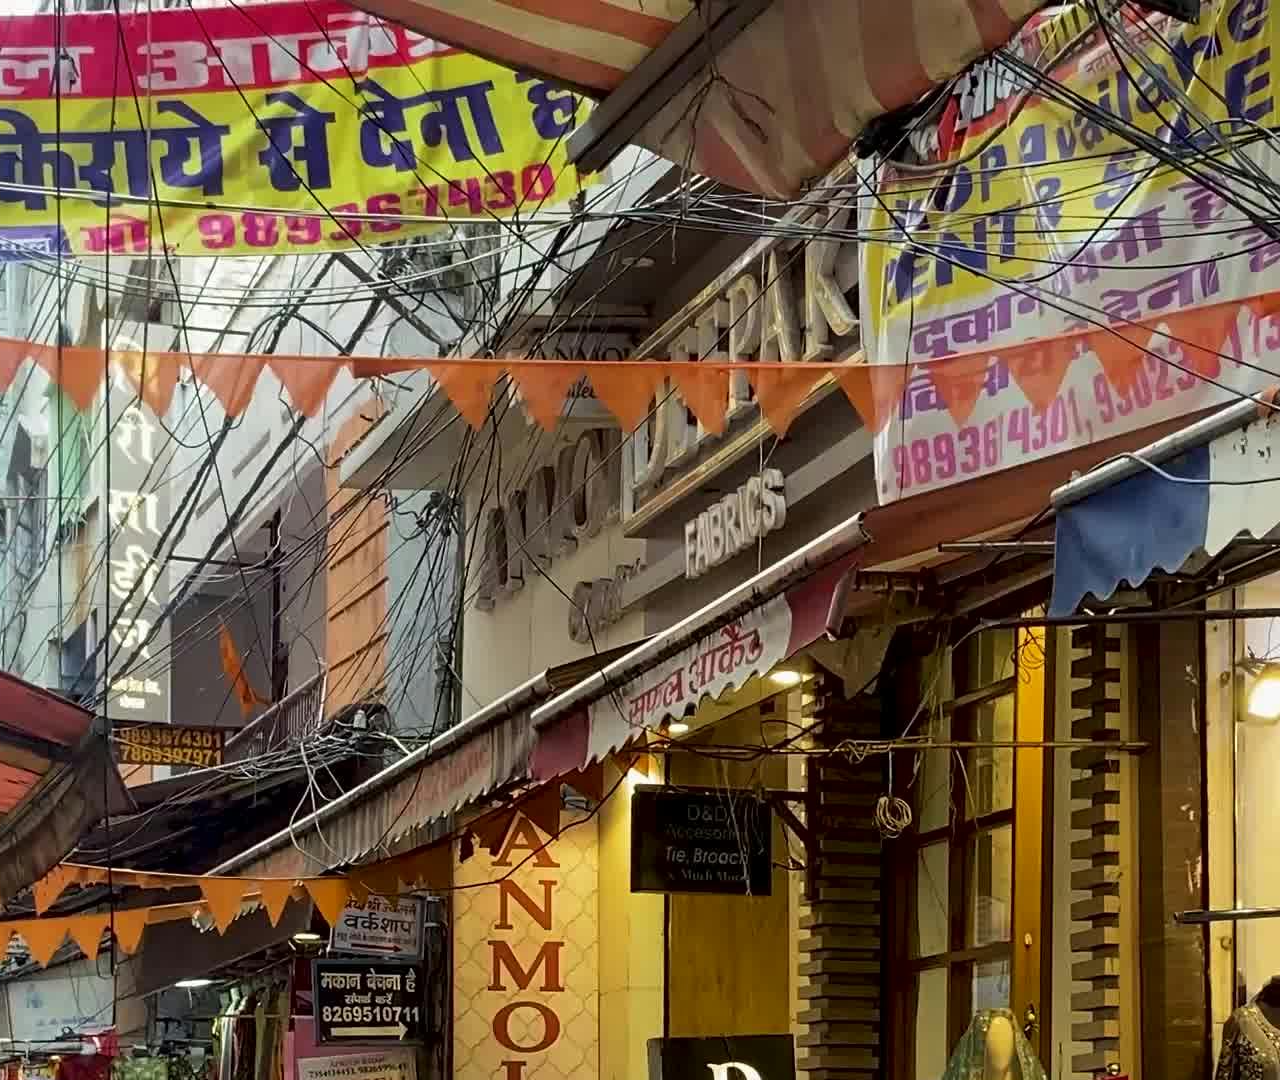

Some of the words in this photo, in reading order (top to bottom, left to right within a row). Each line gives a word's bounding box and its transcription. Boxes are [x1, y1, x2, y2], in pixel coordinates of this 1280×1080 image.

[258, 92, 337, 192] से
[358, 77, 505, 174] देना
[199, 162, 557, 250] 989367430
[684, 467, 788, 581] FABRICS
[320, 972, 362, 990] मकान
[366, 967, 401, 991] बेचना
[405, 967, 417, 993] है
[322, 1005, 419, 1023] 8269510711
